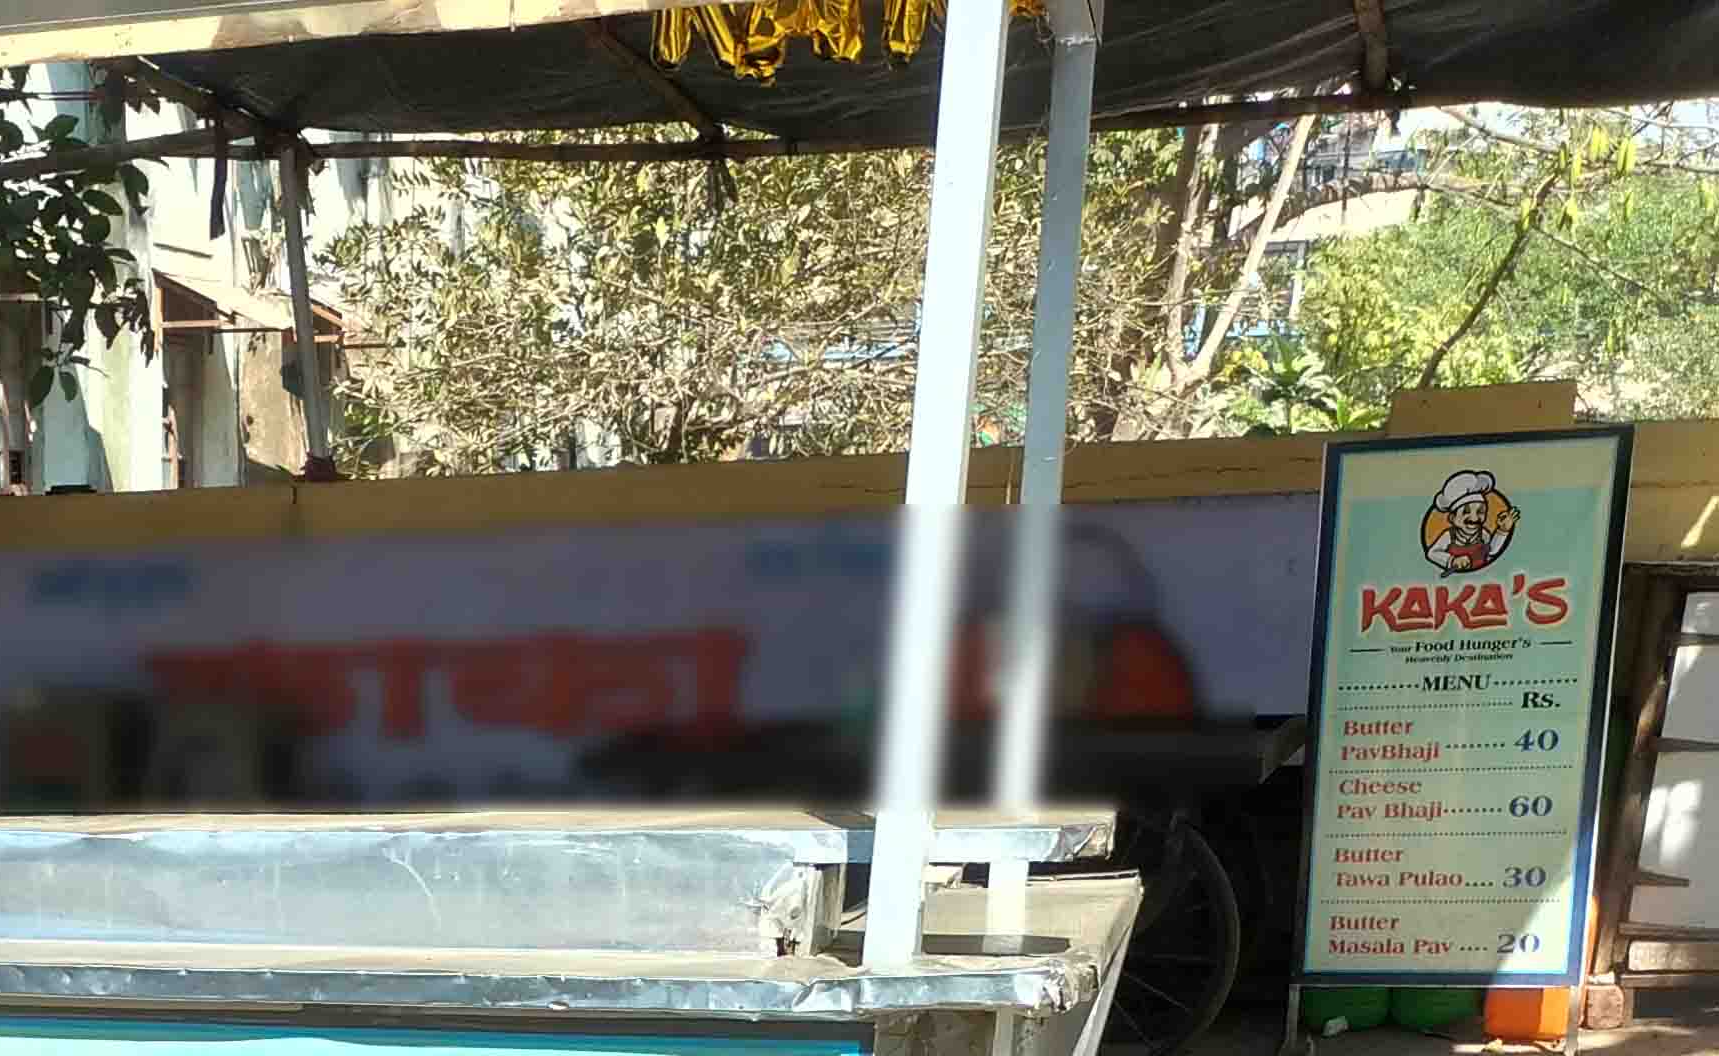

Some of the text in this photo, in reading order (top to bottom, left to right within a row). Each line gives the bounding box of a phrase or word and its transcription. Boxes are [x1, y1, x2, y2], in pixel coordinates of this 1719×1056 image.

[1361, 574, 1568, 632] KAKA'S
[1415, 639, 1454, 652] Food
[1459, 636, 1531, 652] Hunger's
[1421, 674, 1492, 692] MENU
[1521, 692, 1561, 709] Rs.
[1343, 720, 1414, 736] Butter
[1513, 729, 1559, 751] 40
[1339, 778, 1422, 795] Cheese
[1337, 795, 1553, 821] Pav Bhaji 60
[1334, 848, 1404, 863] Butter
[1336, 866, 1546, 888] Tawa Pulao 30
[1329, 916, 1400, 931] Butter
[1328, 933, 1541, 955] Masala Pav 20
